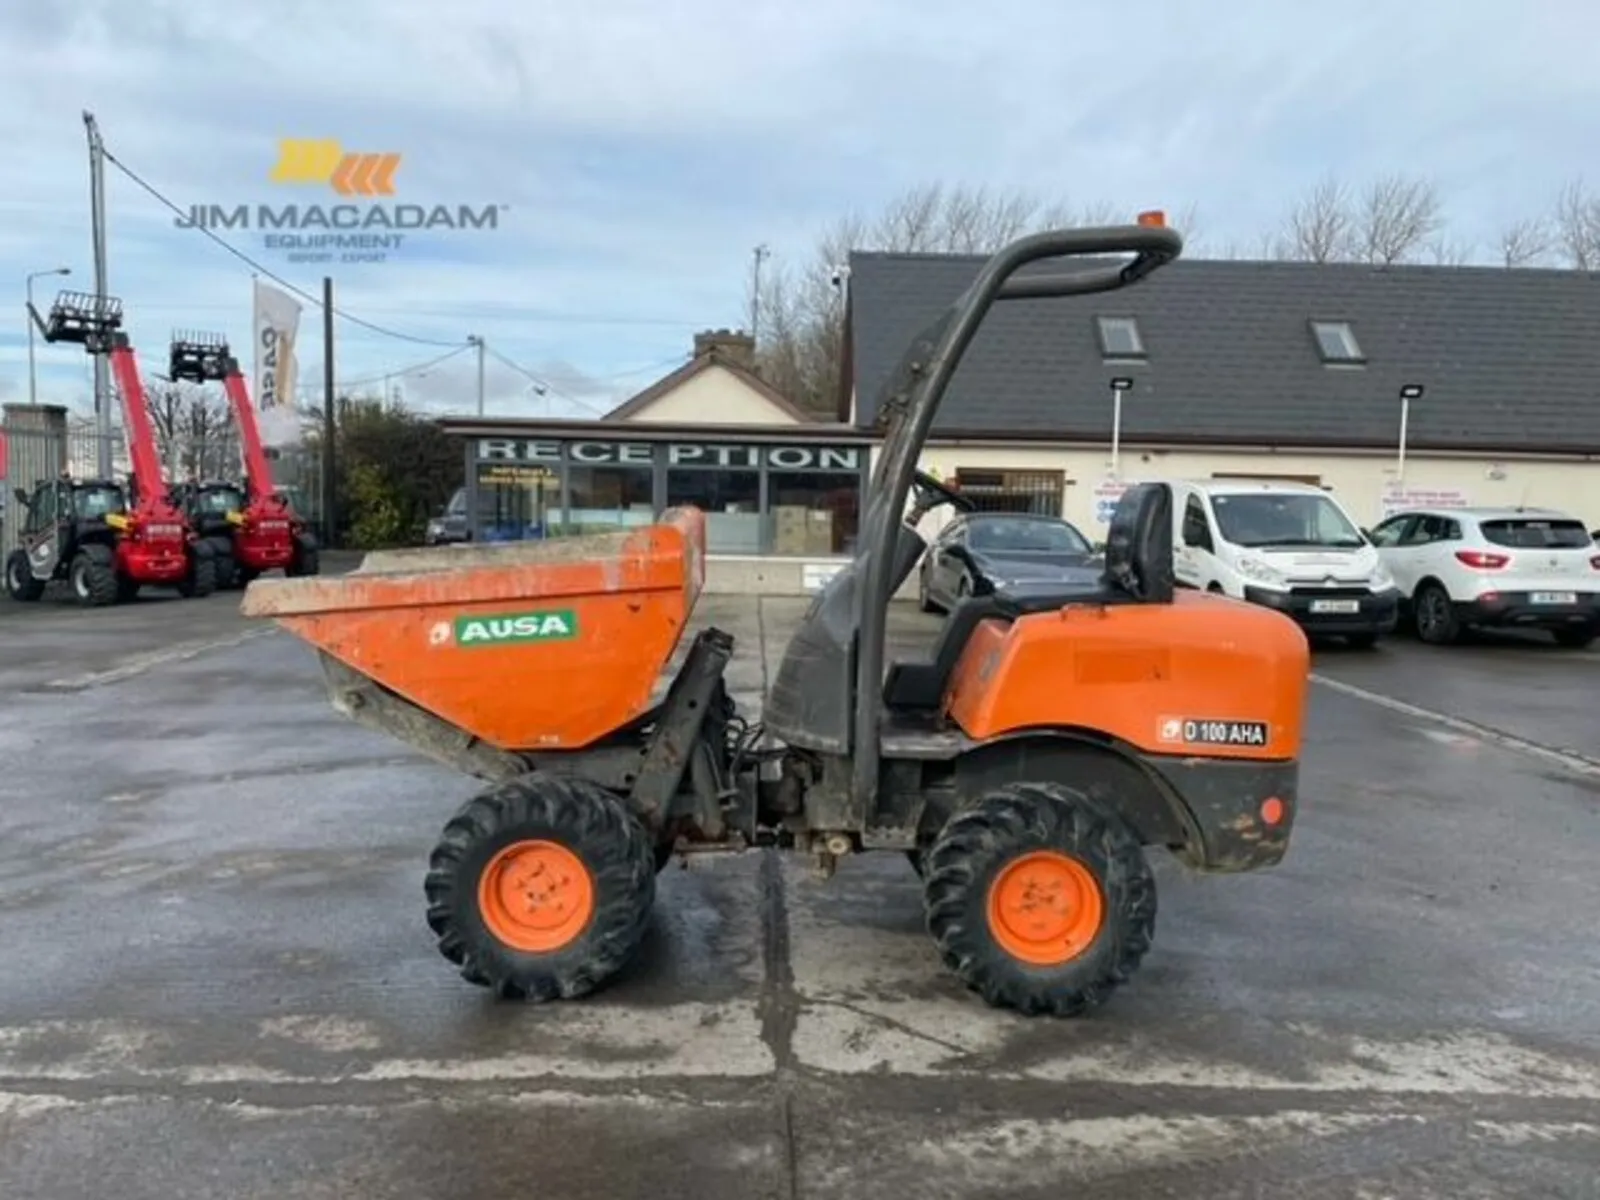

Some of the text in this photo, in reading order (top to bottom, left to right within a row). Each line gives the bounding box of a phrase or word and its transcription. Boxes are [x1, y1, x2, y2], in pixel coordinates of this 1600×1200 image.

[478, 438, 858, 470] RECEPTION
[461, 614, 569, 642] AUSA
[1201, 722, 1227, 742] 100
[1229, 723, 1264, 744] AHA
